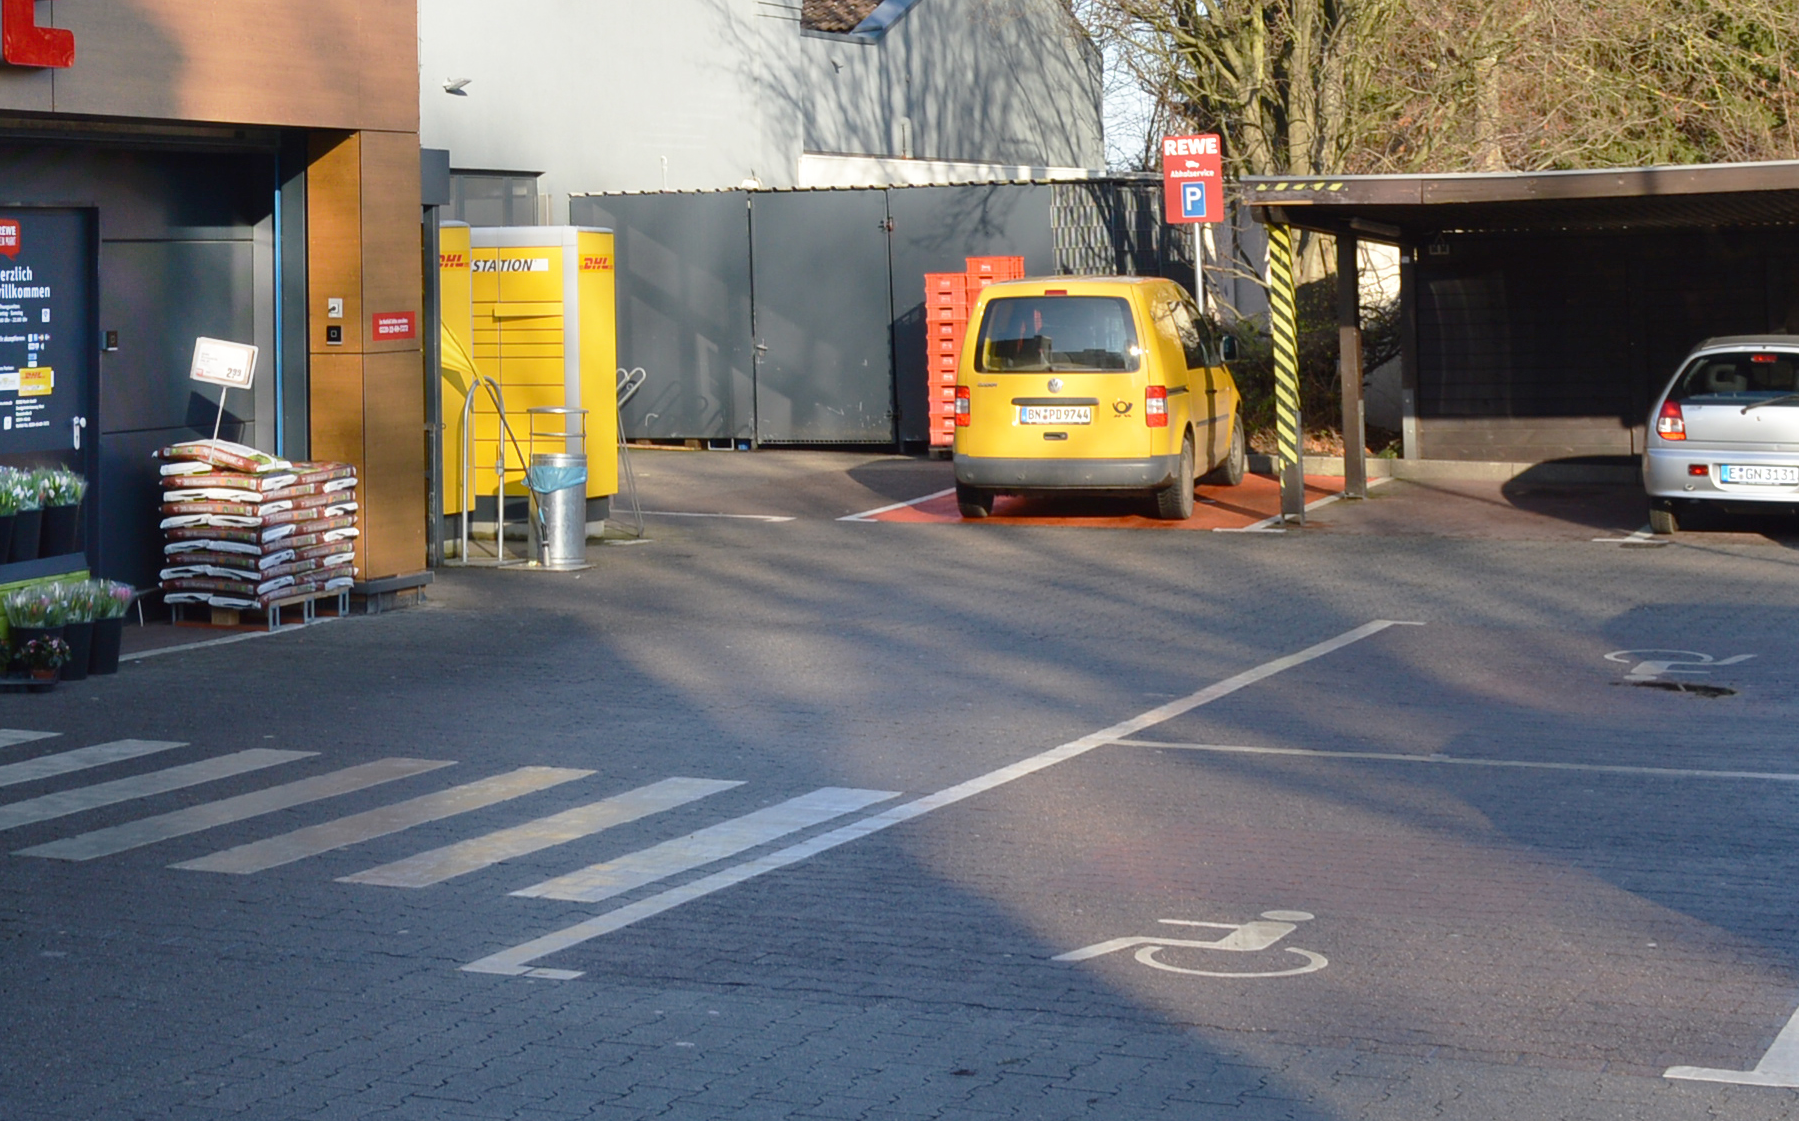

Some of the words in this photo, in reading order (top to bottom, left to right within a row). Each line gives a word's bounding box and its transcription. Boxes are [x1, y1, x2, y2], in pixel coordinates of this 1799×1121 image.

[1164, 138, 1218, 156] REWE
[1170, 169, 1214, 178] Abholservice
[1186, 187, 1202, 211] P
[583, 258, 610, 270] DHL
[1028, 409, 1041, 420] BN
[1049, 409, 1062, 420] PD
[1063, 409, 1089, 420] 9744
[1729, 468, 1736, 479] E
[1745, 468, 1762, 480] GN
[1765, 469, 1795, 481] 3131
